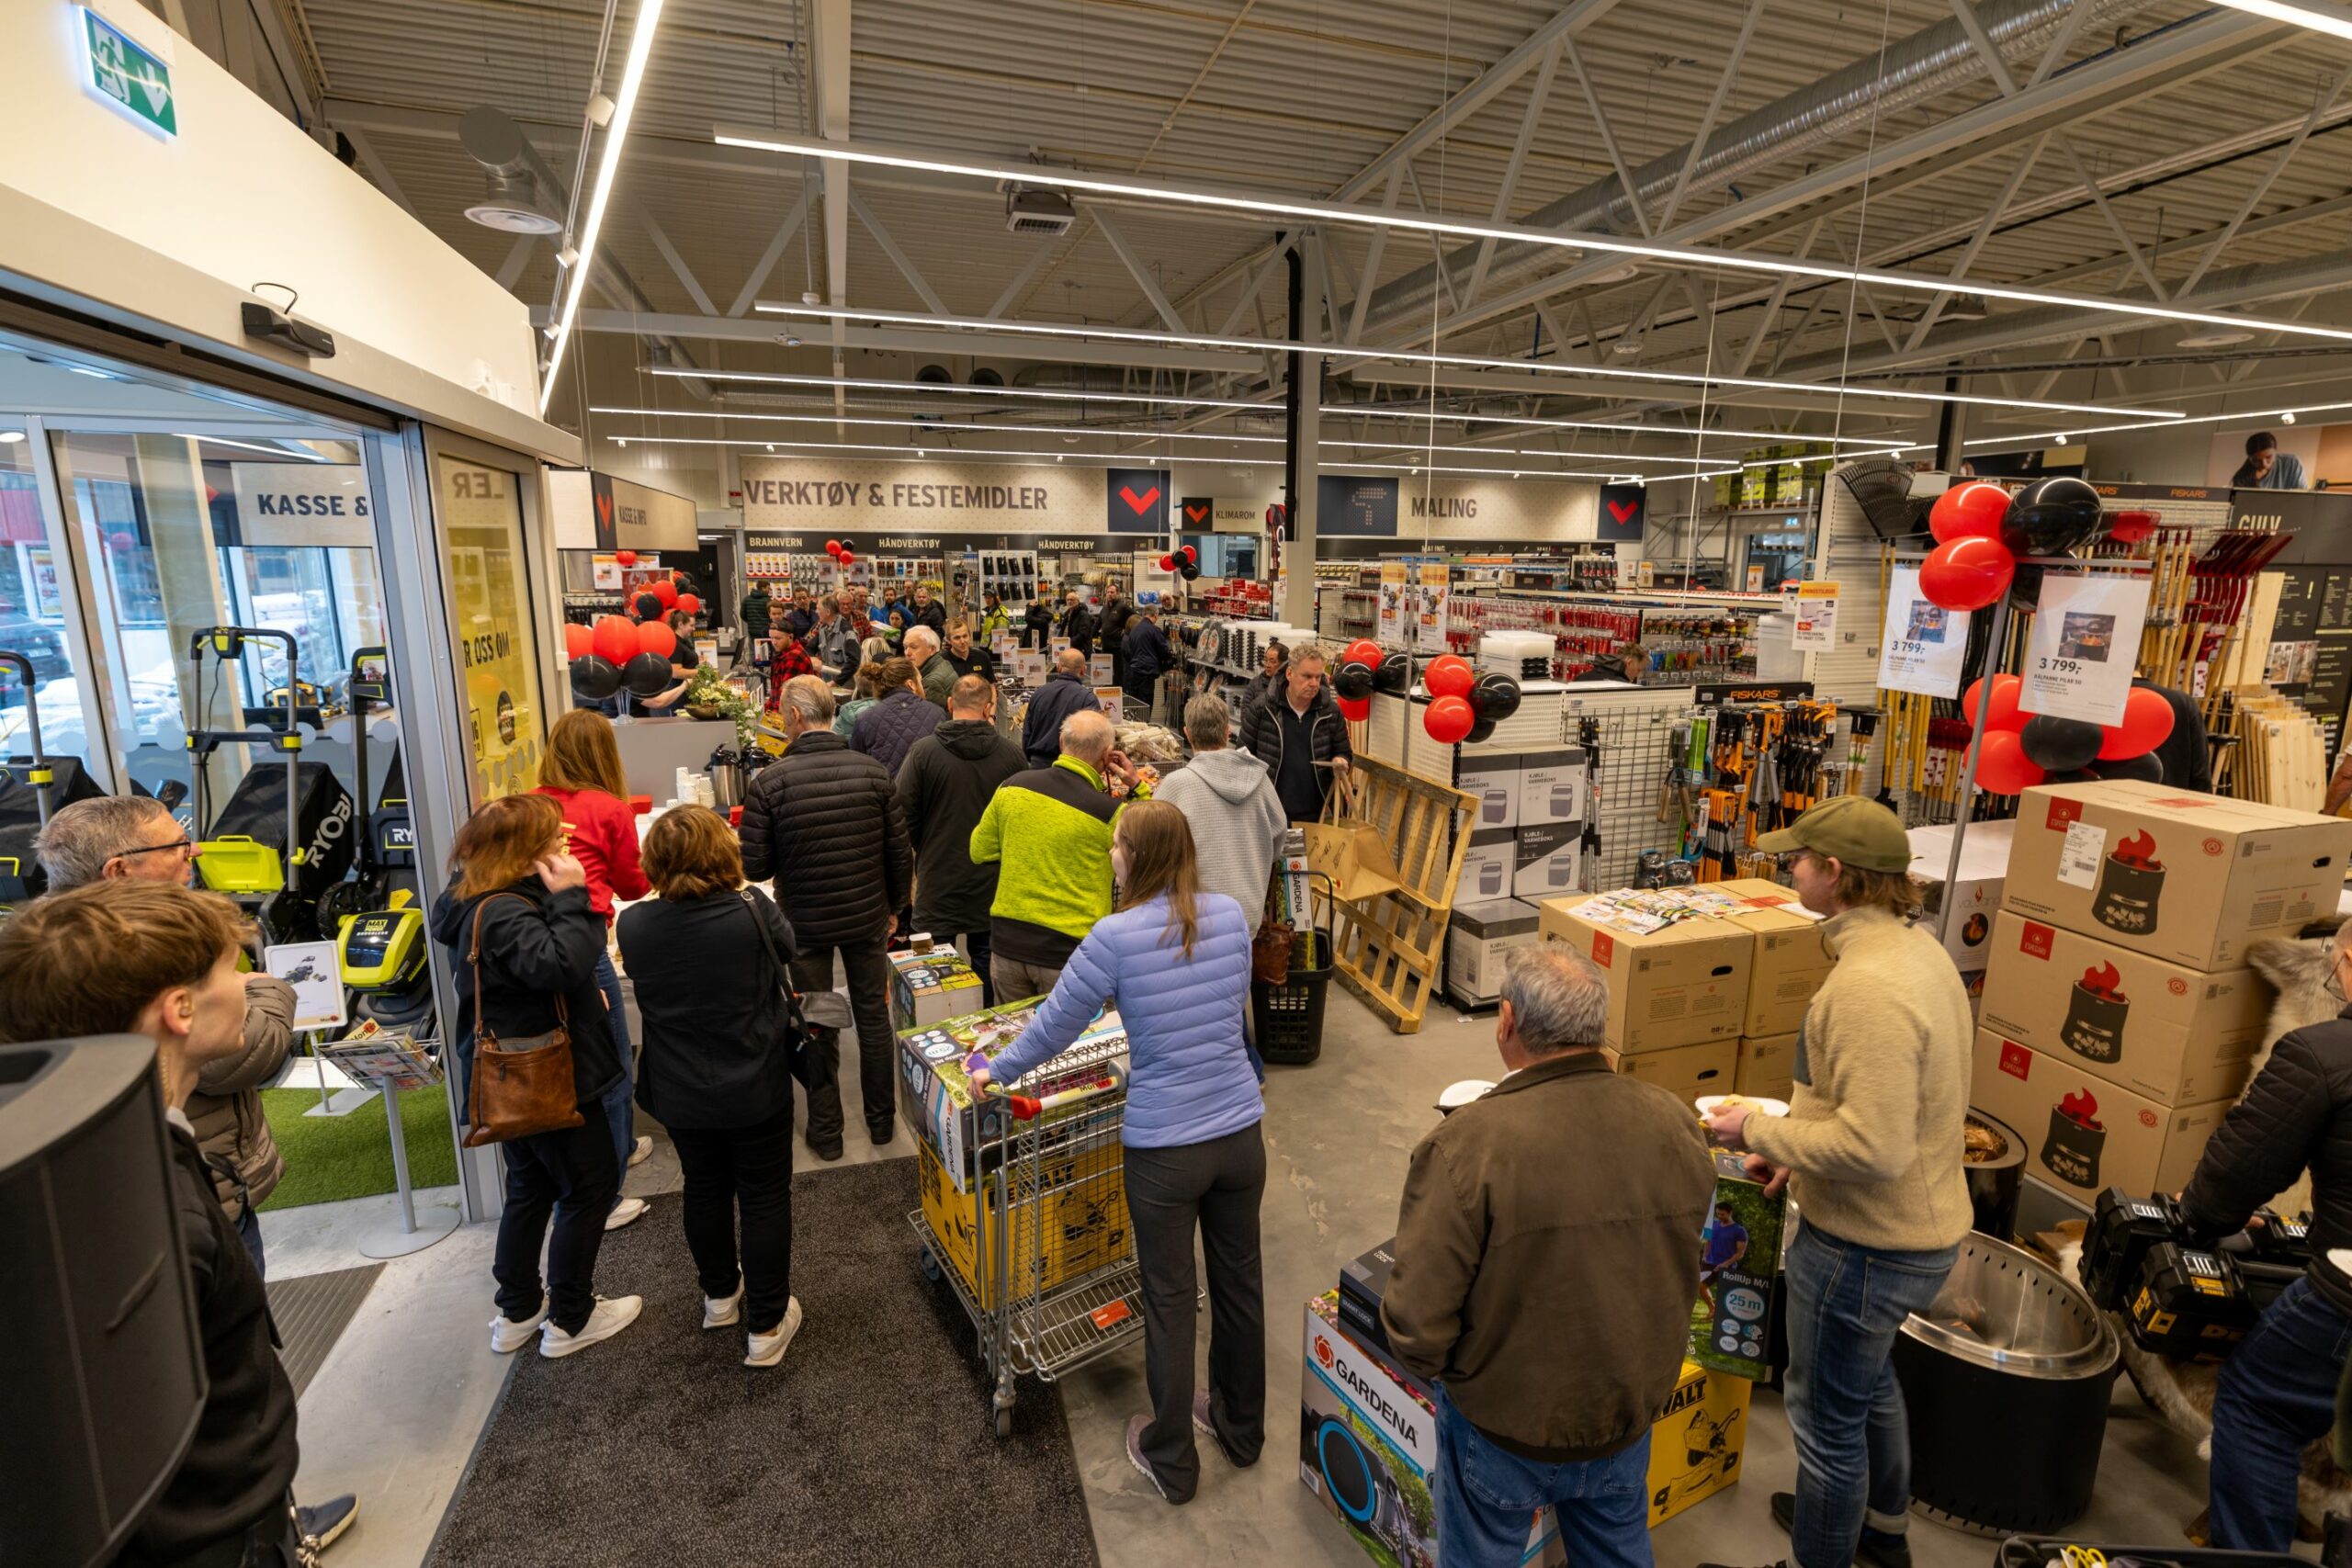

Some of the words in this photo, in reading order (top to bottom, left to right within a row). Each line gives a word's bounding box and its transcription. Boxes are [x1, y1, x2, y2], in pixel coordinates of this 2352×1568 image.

[743, 479, 861, 507] VERKTØY
[868, 483, 886, 506] &
[893, 483, 1047, 510] FESTEMIDLER
[2093, 486, 2118, 495] KARS
[2170, 489, 2208, 498] FISKARS
[257, 493, 345, 516] KASSE
[1411, 497, 1477, 518] MALING
[618, 505, 634, 525] KASSE
[1216, 510, 1256, 520] KLIMAROM
[749, 536, 803, 547] BRANNVERN
[878, 537, 941, 549] HÅNDVERKTØY
[1038, 539, 1095, 550] HÅNDVERKTØY
[474, 636, 494, 666] OSS
[495, 630, 512, 659] OM
[1892, 640, 1898, 651] 3
[2039, 658, 2047, 670] 3
[2034, 674, 2058, 682] BÅLPANNE
[1730, 690, 1780, 699] FISKARS
[305, 794, 355, 869] RYOBI
[945, 1117, 956, 1174] GARDENA
[1374, 1252, 1388, 1264] LOCK
[1378, 1249, 1396, 1263] SMART
[1723, 1271, 1752, 1286] RollUp
[1753, 1278, 1770, 1289] M/L
[1729, 1293, 1747, 1308] 25
[1747, 1300, 1761, 1311] m
[1342, 1299, 1359, 1315] SMART
[1359, 1309, 1373, 1325] LOCK
[1336, 1359, 1418, 1449] GARDENA
